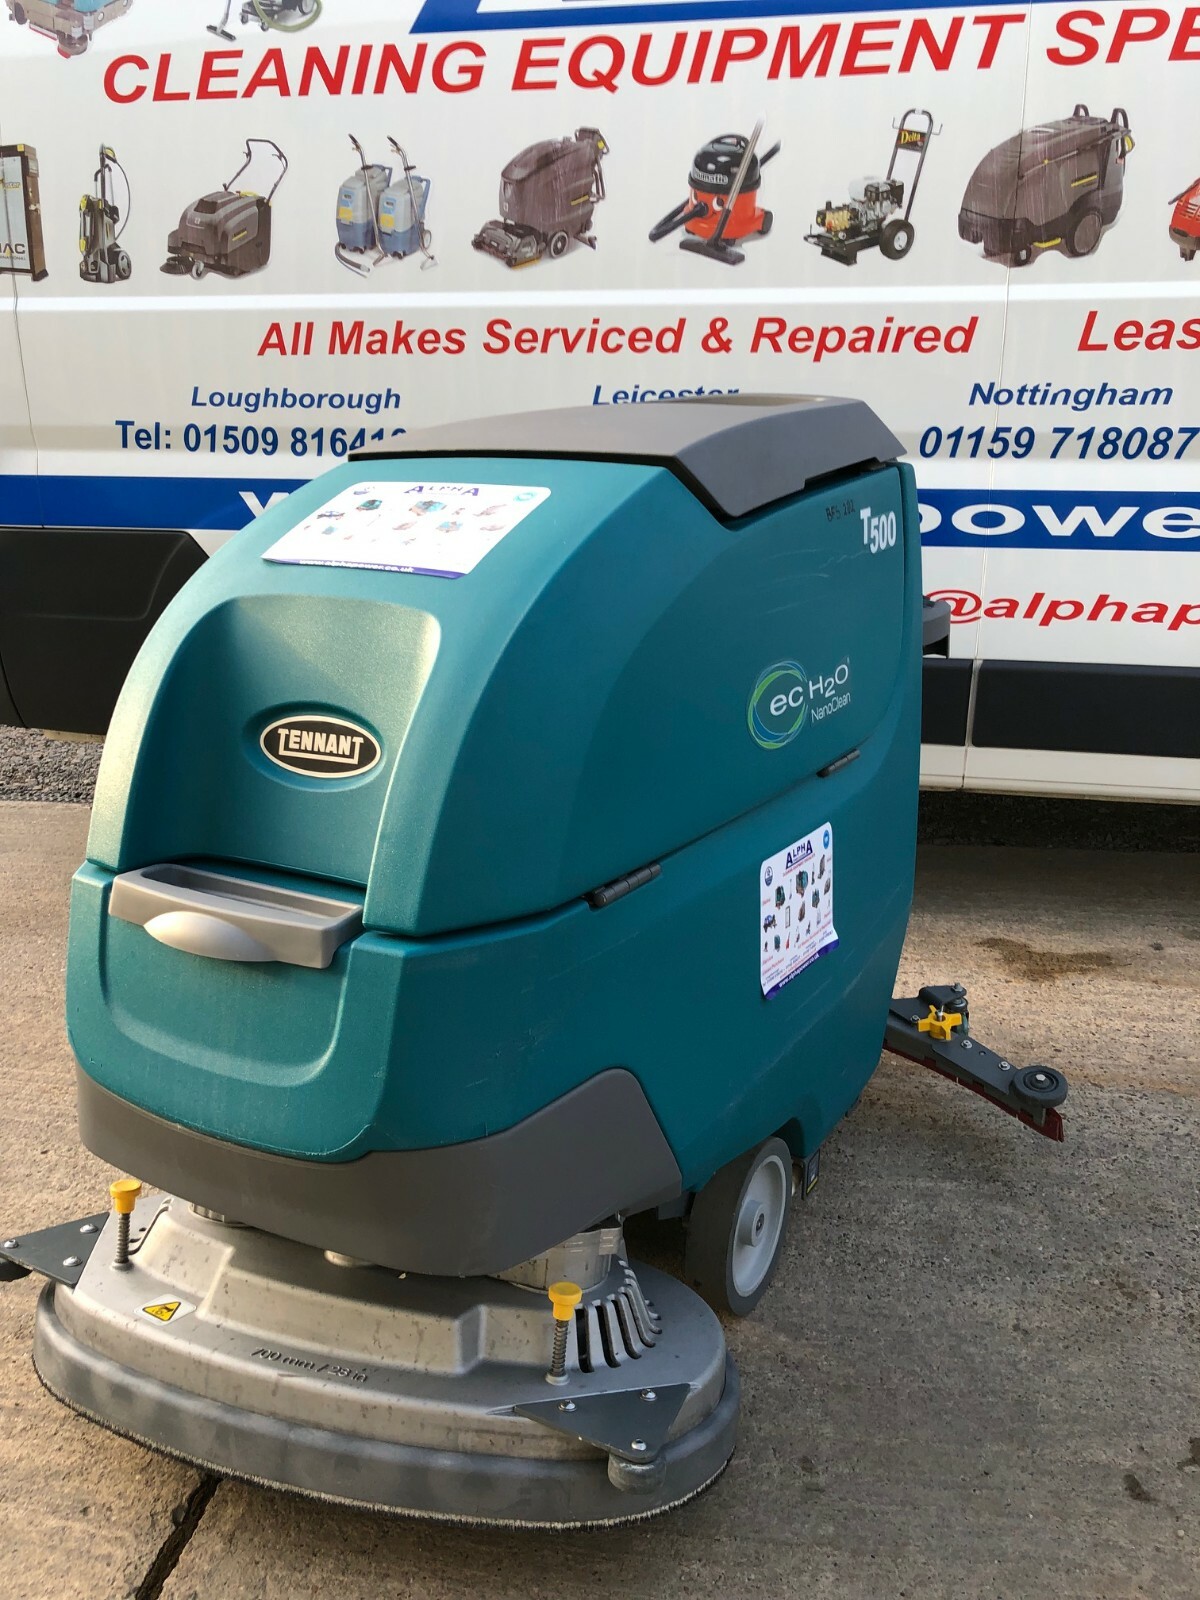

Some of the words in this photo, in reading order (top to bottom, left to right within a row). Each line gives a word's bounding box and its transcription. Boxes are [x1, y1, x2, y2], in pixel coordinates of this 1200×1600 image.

[104, 41, 486, 104] CLEANING
[512, 14, 1025, 93] EQUIPMENT
[1046, 7, 1200, 66] SPE
[258, 322, 314, 355] All
[328, 320, 465, 355] Makes
[483, 318, 686, 354] Serviced
[701, 317, 732, 354] &
[750, 316, 979, 362] Repaired
[1078, 311, 1200, 351] Leas
[192, 387, 400, 414] Loughborough
[969, 383, 1174, 412] Nottingham
[116, 420, 170, 449] Tel:
[184, 424, 278, 455] 01509
[920, 426, 1035, 459] 01159
[1051, 427, 1200, 460] 718087
[860, 506, 897, 554] T500
[811, 692, 851, 724] NanoClean
[278, 728, 364, 765] TENNANT
[785, 840, 813, 870] ALPHA
[251, 1347, 281, 1361] 700
[282, 1356, 315, 1371] mm
[328, 1365, 351, 1378] 28
